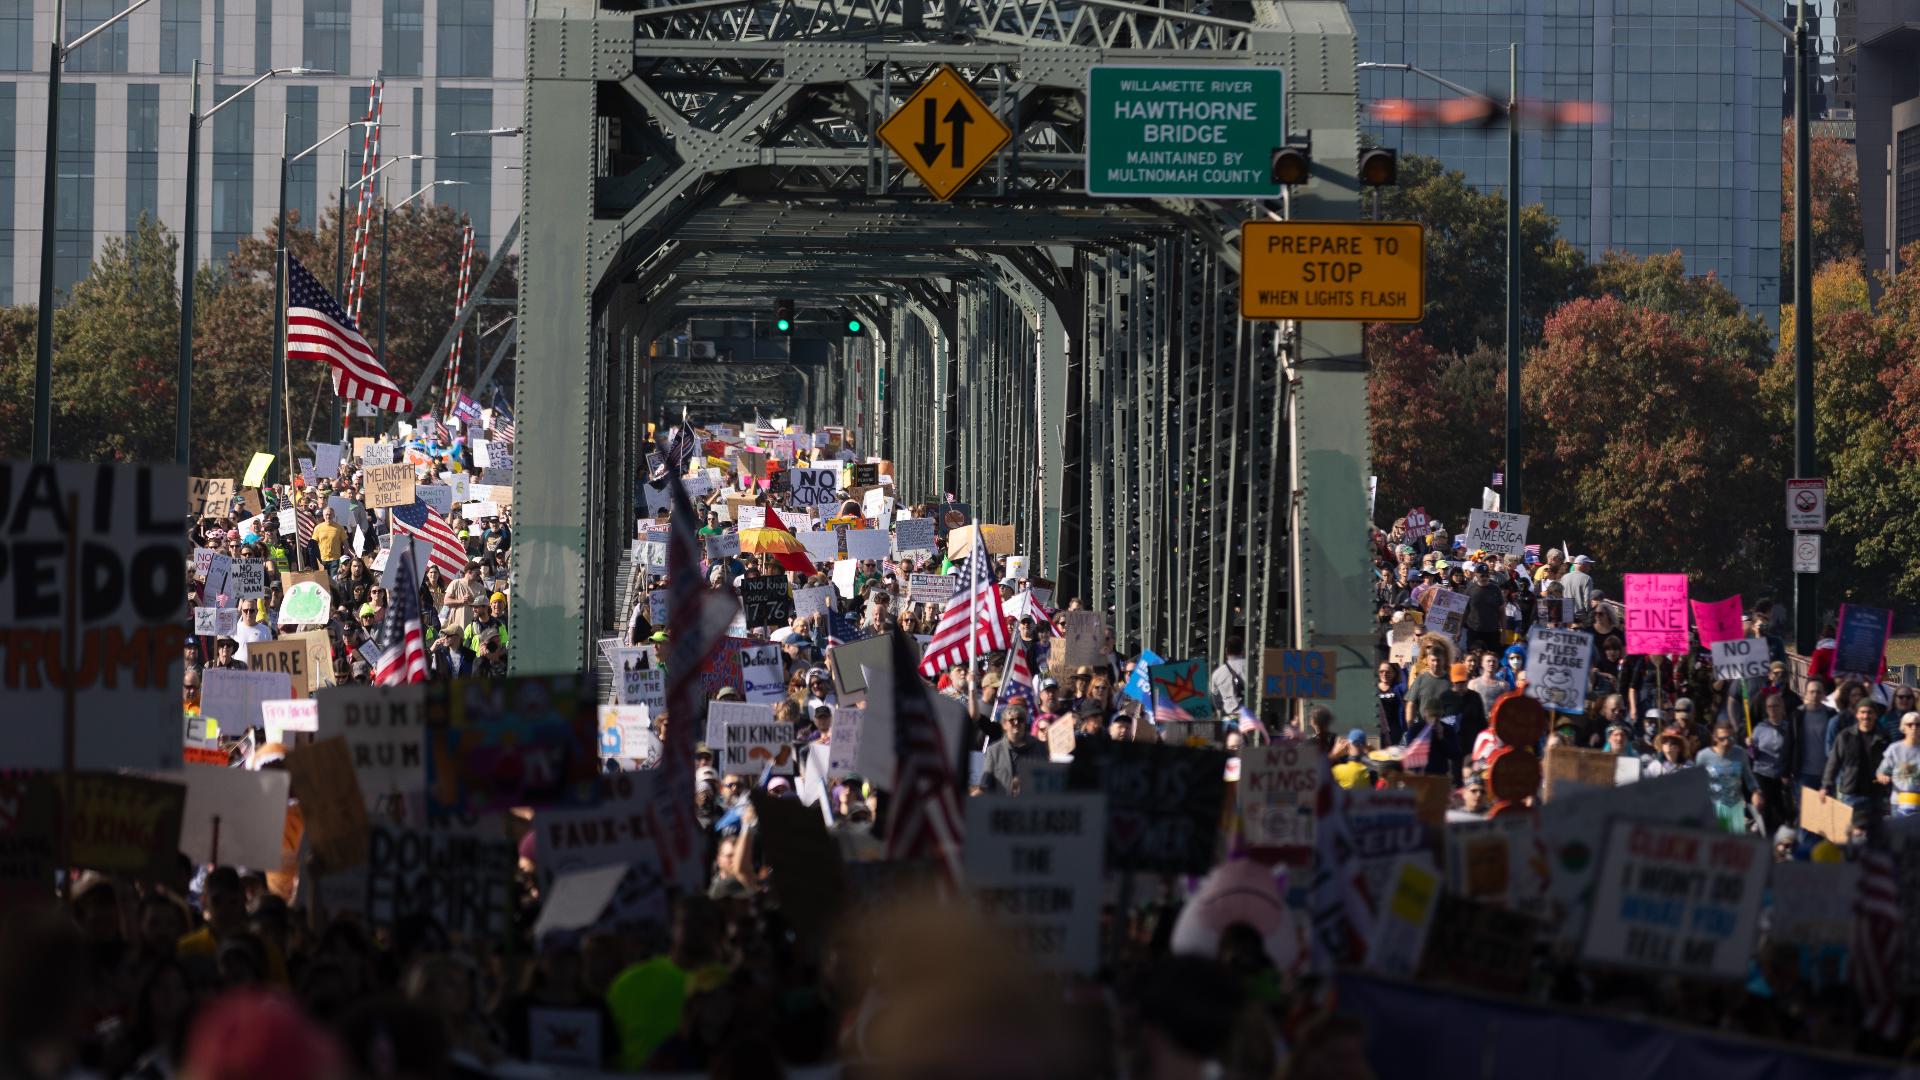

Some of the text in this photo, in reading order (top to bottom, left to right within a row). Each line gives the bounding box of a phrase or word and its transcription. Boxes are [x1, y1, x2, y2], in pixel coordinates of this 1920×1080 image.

[1120, 80, 1252, 93] WILLAMETTE RIVER
[1114, 101, 1257, 120] HAWTHORNE
[1144, 124, 1227, 143] BRIDGE
[1127, 151, 1244, 165] MAINTAINED BY
[1108, 168, 1262, 183] MULTNOMAH COUNTY
[1268, 235, 1399, 255] PREPARE TO
[1302, 262, 1362, 282] STOP
[1258, 290, 1406, 307] WHEN LIGHTS FLASH
[366, 446, 391, 457] BLAME
[377, 481, 401, 492] WRONG
[800, 469, 836, 488] NO
[375, 492, 402, 505] BIBLE
[790, 485, 836, 506] KINGS
[197, 498, 229, 518] ICE!
[1473, 528, 1523, 544] AMERICA
[1480, 541, 1515, 554] PROTEST
[232, 570, 262, 579] MASTERS
[243, 585, 262, 593] MAN
[1627, 575, 1684, 592] Portland
[1628, 608, 1682, 629] FINE
[1538, 630, 1589, 647] EPSTEIN
[741, 647, 778, 667] Defend
[1545, 642, 1578, 656] FILES
[1724, 640, 1751, 657] NO
[251, 651, 302, 675] MORE
[1282, 650, 1325, 676] NO
[1538, 653, 1584, 669] PLEASE
[626, 670, 660, 682] POWER
[1714, 660, 1771, 680] KINGS
[627, 682, 660, 694] OF THE
[1266, 674, 1333, 698] KING
[727, 724, 792, 744] NO KINGS
[727, 746, 747, 765] NO
[1265, 748, 1299, 767] NO
[1249, 768, 1317, 792] KINGS
